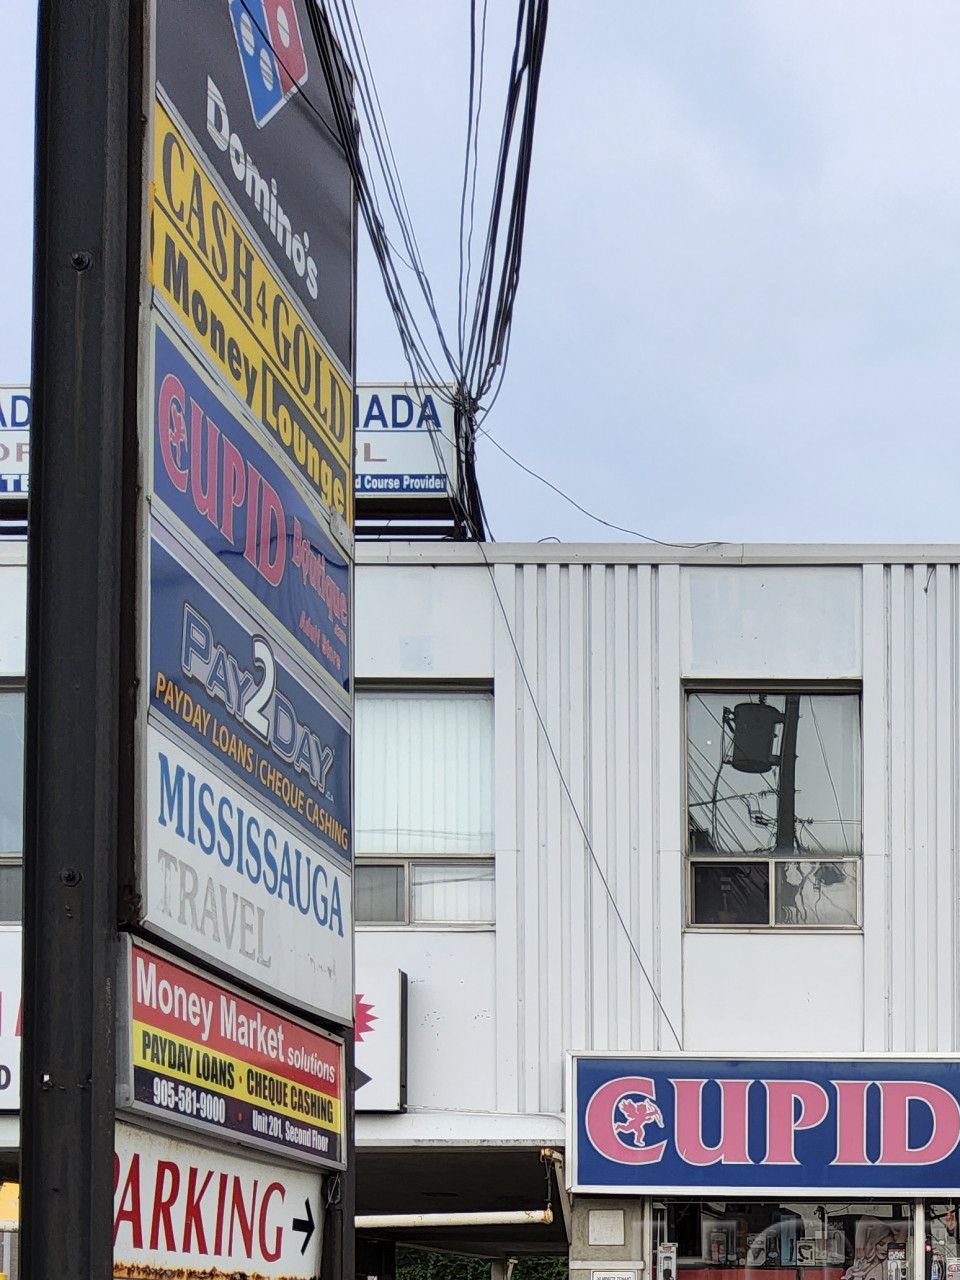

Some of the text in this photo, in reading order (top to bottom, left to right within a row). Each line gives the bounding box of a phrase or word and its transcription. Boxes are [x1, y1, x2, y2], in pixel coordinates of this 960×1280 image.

[206, 75, 319, 301] Domino's
[163, 231, 345, 514] Money Lounge
[158, 373, 288, 588] CUPID
[364, 475, 401, 489] Course
[402, 475, 446, 489] Provider
[156, 671, 348, 851] PAYDAY LOANS CHEQUE CASHING
[157, 848, 272, 968] TRAVEL
[158, 751, 344, 938] MISSISSAUGA
[136, 956, 336, 1084] Money Market solutions
[141, 1029, 334, 1124] PAYDAY LOANS CHEQUE CASHING
[153, 1077, 329, 1152] 905-581-9000 Unit 201, Second Floor
[114, 1151, 287, 1263] ARKING
